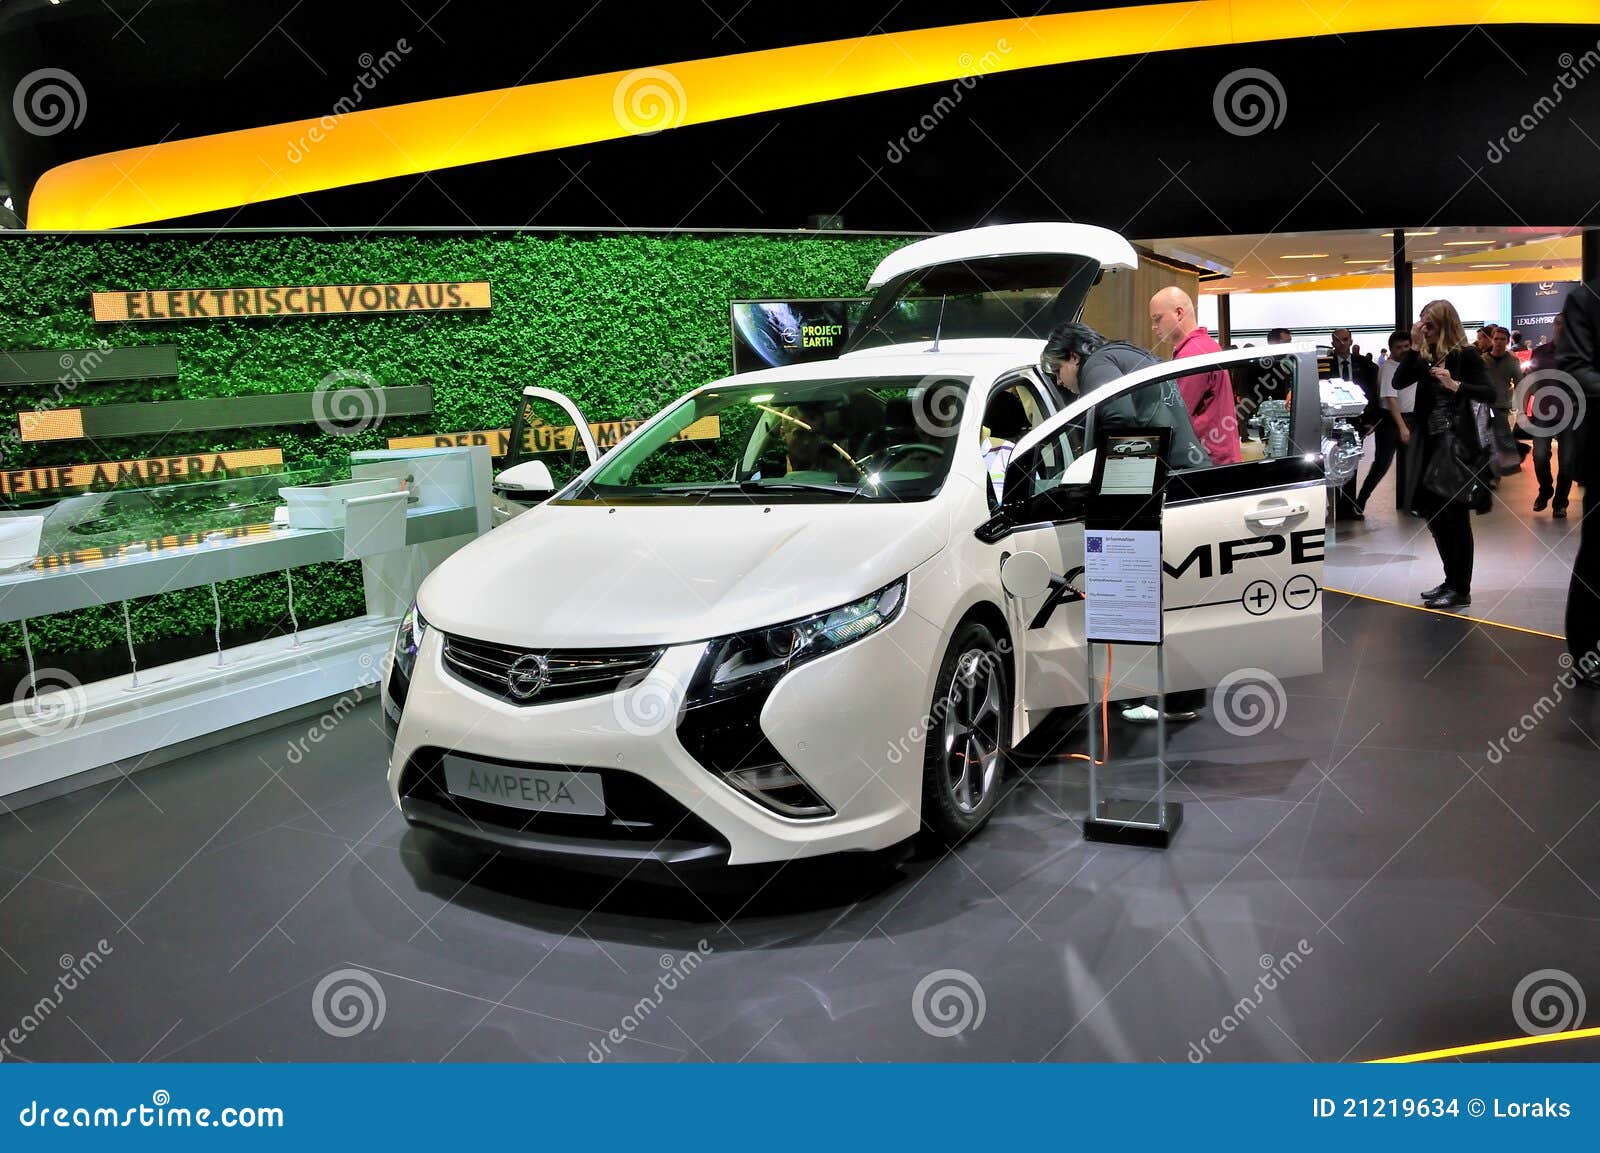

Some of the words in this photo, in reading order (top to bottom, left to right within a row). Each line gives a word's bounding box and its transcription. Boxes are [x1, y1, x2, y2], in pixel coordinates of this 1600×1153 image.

[126, 288, 326, 319] ELEKTRISCH
[336, 284, 471, 311] VORAUS.
[1517, 317, 1536, 326] LEXUS
[802, 325, 843, 336] PROJECT
[803, 336, 833, 348] EARTH
[468, 768, 575, 804] AMPERA
